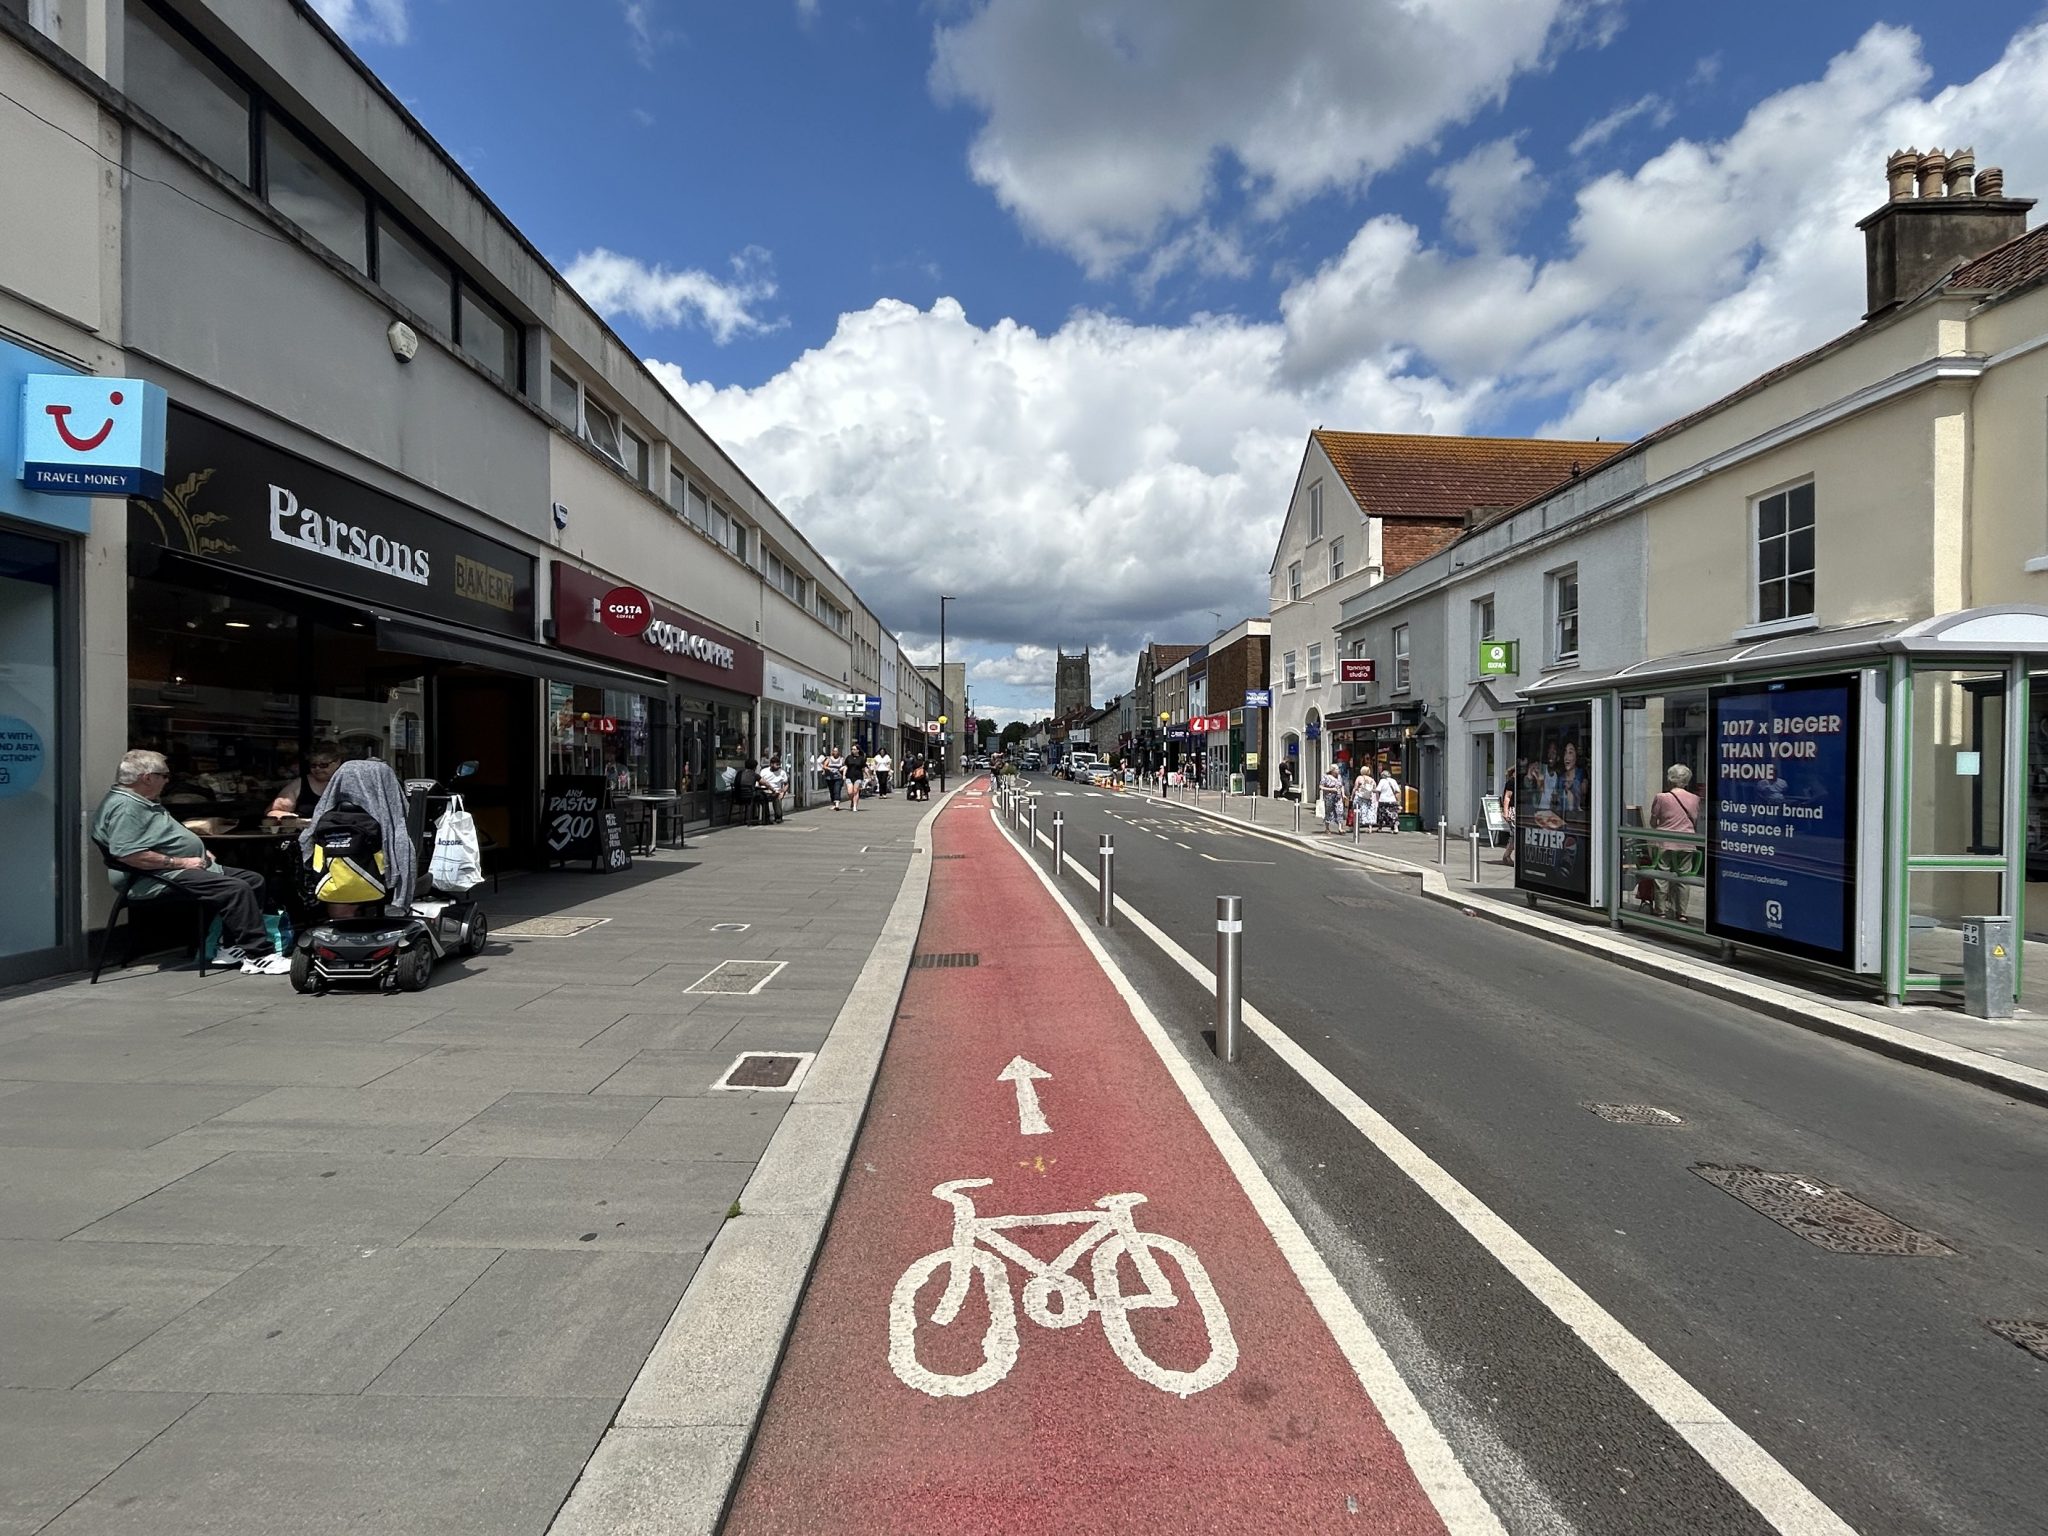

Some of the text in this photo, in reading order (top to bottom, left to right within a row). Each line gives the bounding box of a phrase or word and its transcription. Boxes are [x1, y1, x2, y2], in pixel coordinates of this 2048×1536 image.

[36, 471, 128, 487] TRAVEL MONEY
[268, 484, 429, 586] Parsons
[457, 562, 513, 604] BAKERY
[609, 604, 643, 615] COSTA
[642, 617, 734, 670] COSTA COFFEE
[1346, 664, 1371, 672] tanning
[1722, 715, 1841, 736] 1017 x BIGGER
[7, 732, 33, 740] WITH
[16, 743, 40, 751] ASTA
[1721, 741, 1817, 759] THAN YOUR
[1721, 763, 1775, 780] PHONE
[550, 796, 598, 811] PASTY
[1721, 800, 1824, 819] Give your brand
[1720, 819, 1795, 838] the space it
[1524, 827, 1566, 850] BETTER
[1720, 838, 1775, 856] deserves
[1524, 845, 1557, 867] WITH
